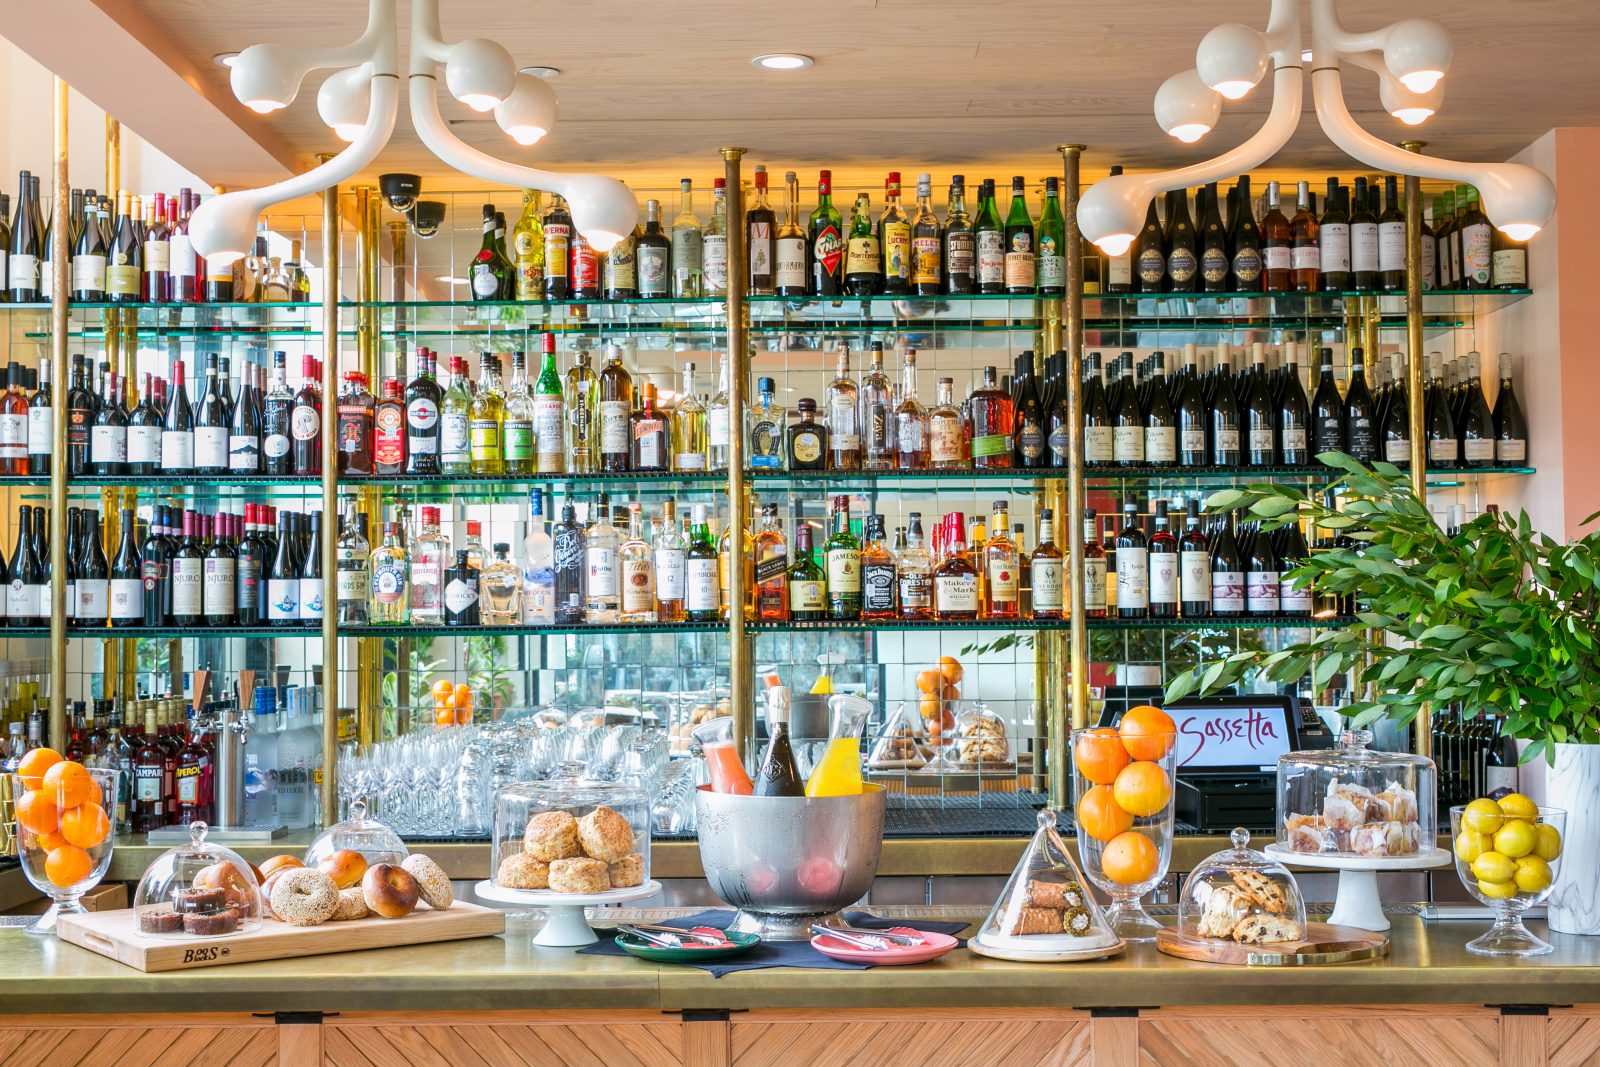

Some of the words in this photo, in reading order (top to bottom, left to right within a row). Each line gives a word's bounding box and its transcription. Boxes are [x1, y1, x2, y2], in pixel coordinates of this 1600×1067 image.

[374, 565, 398, 586] PLYMOUTH
[396, 573, 404, 585] GIN
[867, 569, 878, 578] JACK
[1179, 704, 1279, 768] Sassetta
[176, 766, 201, 777] APEROL
